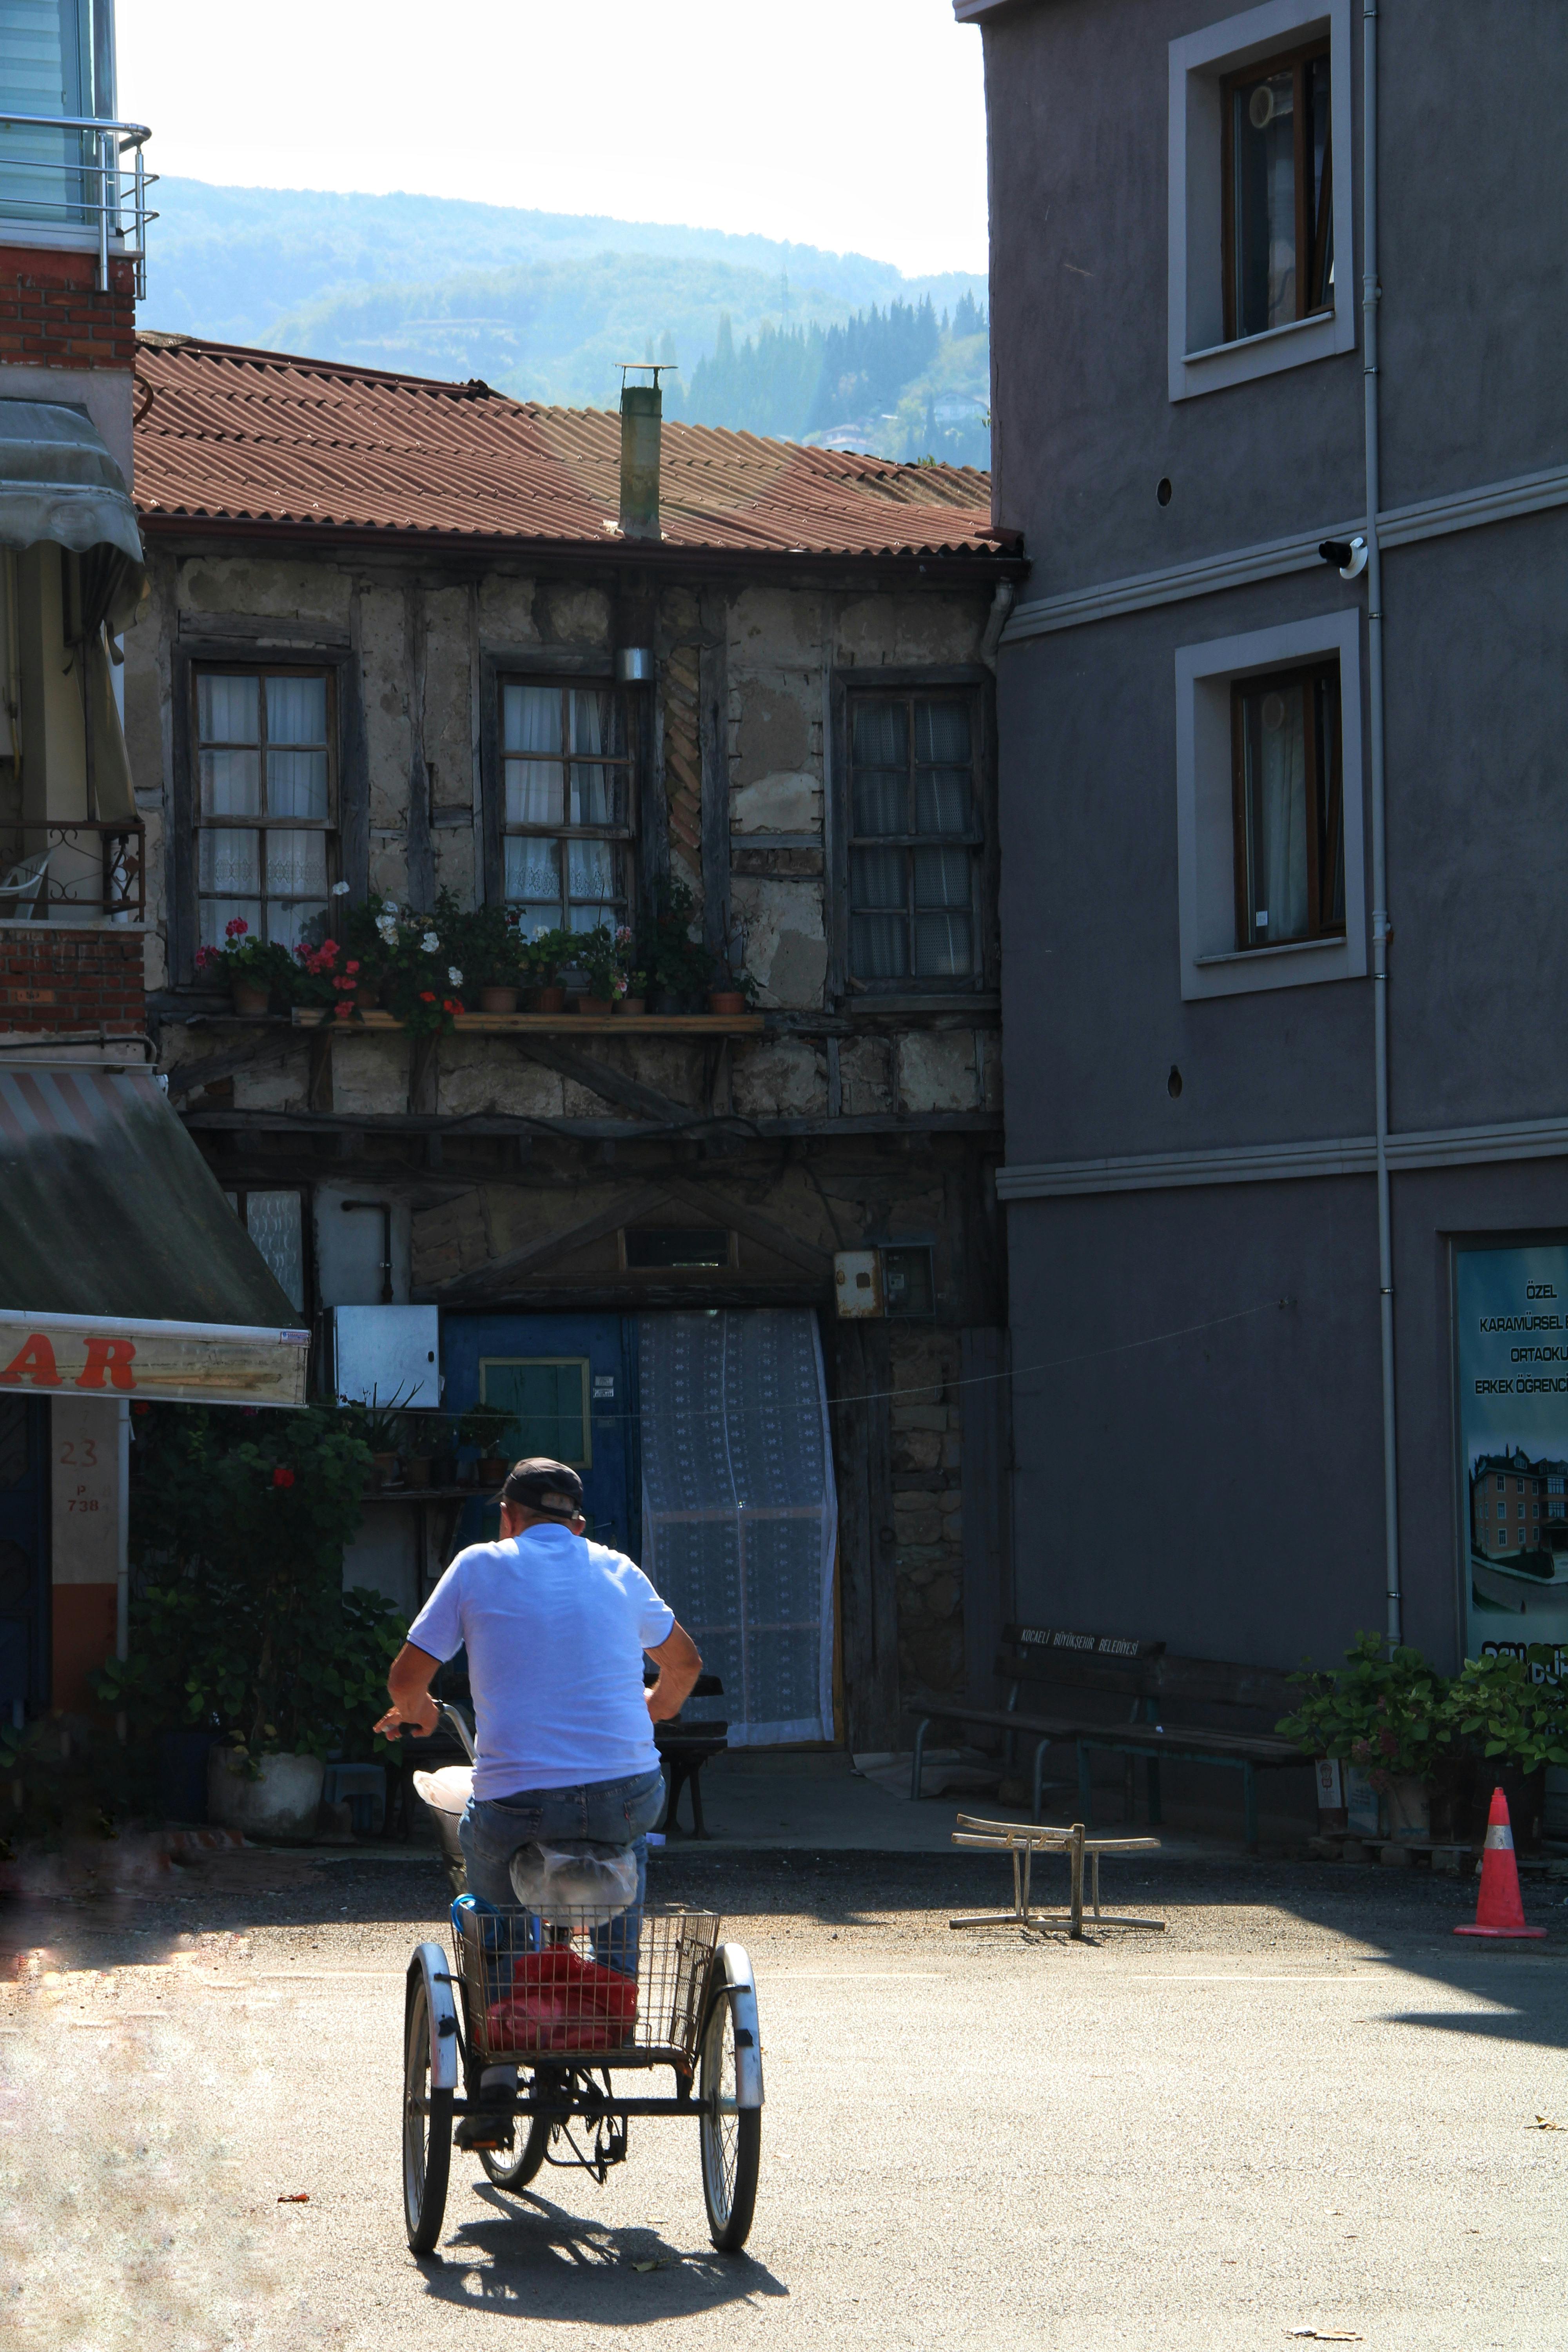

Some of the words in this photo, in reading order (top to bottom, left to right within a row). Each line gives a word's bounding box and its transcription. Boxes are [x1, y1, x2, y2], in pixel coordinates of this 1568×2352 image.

[1526, 1280, 1557, 1299] ÖZEL
[1480, 1312, 1563, 1332] KARAMÜRSEL
[0, 1333, 137, 1390] AR
[1511, 1347, 1568, 1362] ORTAOKU
[1475, 1379, 1514, 1394] ERKEK
[60, 1439, 97, 1468] 23
[67, 1499, 99, 1512] 738
[1021, 1629, 1051, 1644] KOCAELİ
[1053, 1631, 1095, 1650] BÜYÜKŞEHİR
[1098, 1639, 1139, 1656] BELEDİYESİ
